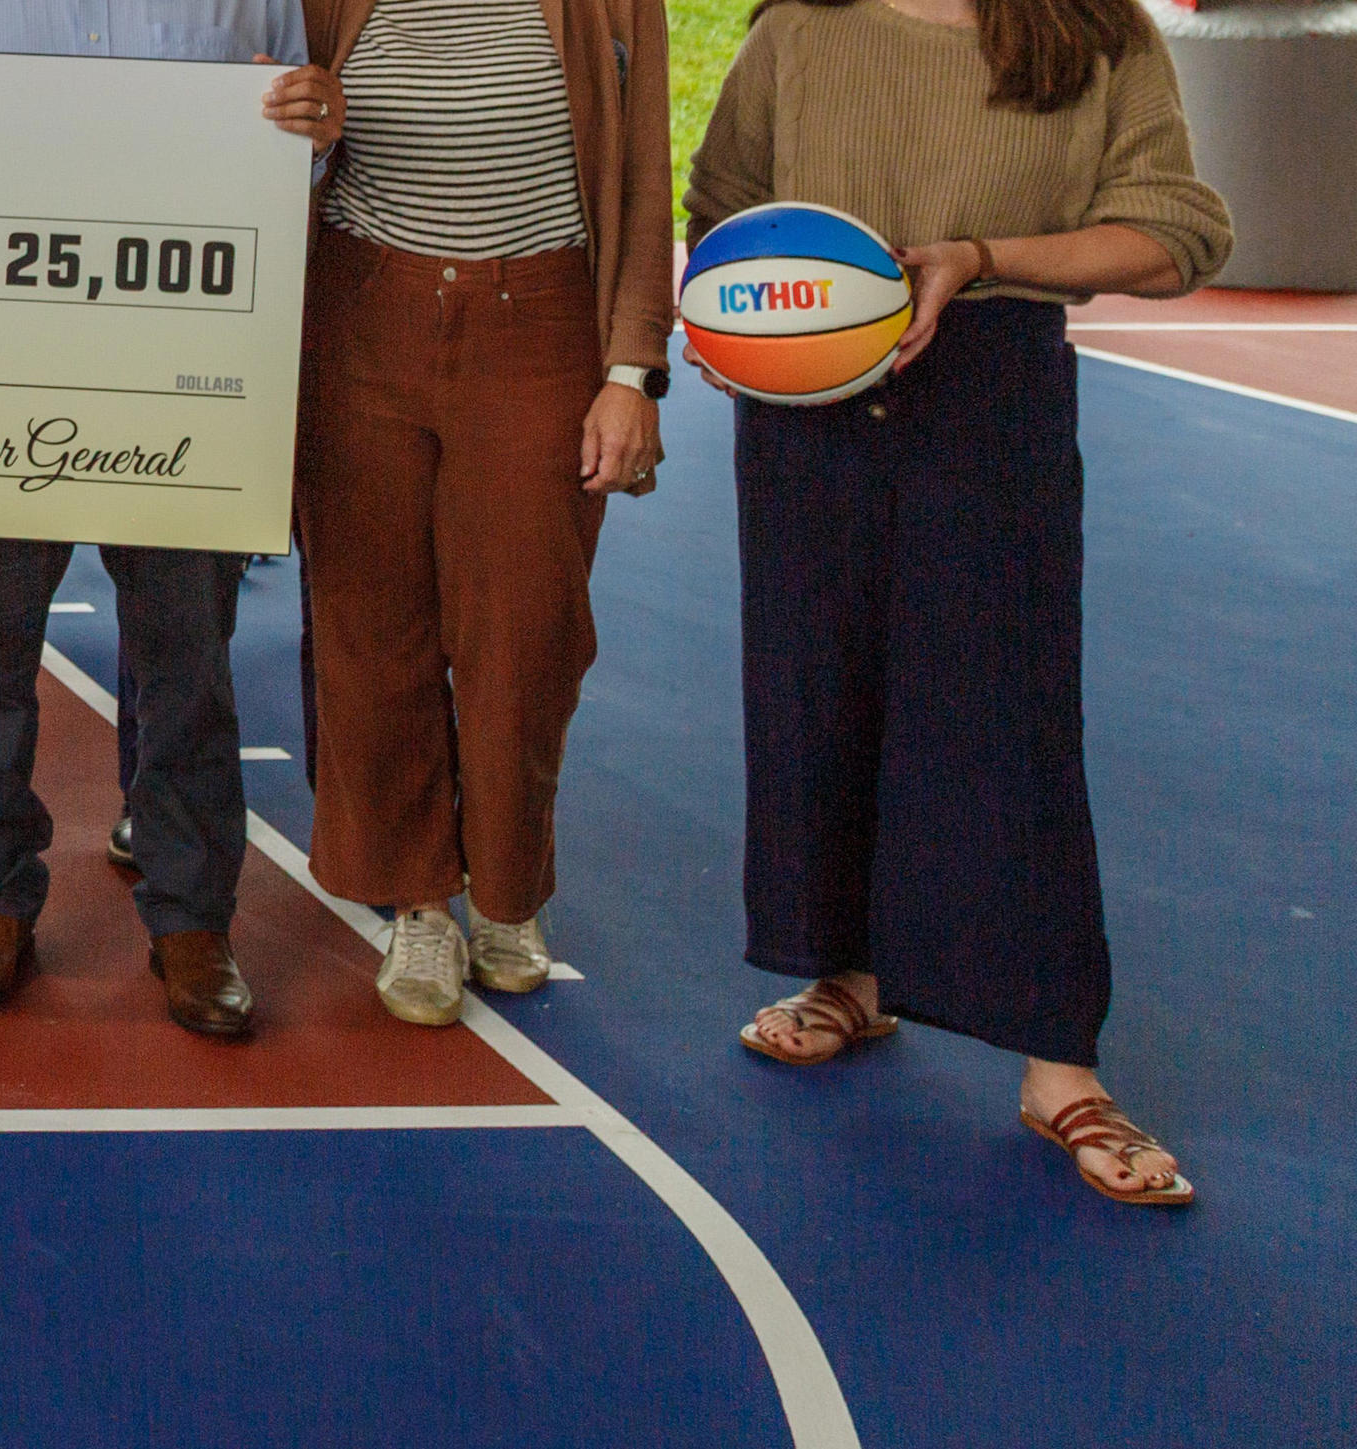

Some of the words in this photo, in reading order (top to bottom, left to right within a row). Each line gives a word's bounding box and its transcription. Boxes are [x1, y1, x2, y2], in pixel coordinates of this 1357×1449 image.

[5, 232, 235, 301] 25,000
[719, 279, 833, 314] ICYHOT
[175, 374, 244, 393] DOLLARS
[19, 417, 191, 493] General
